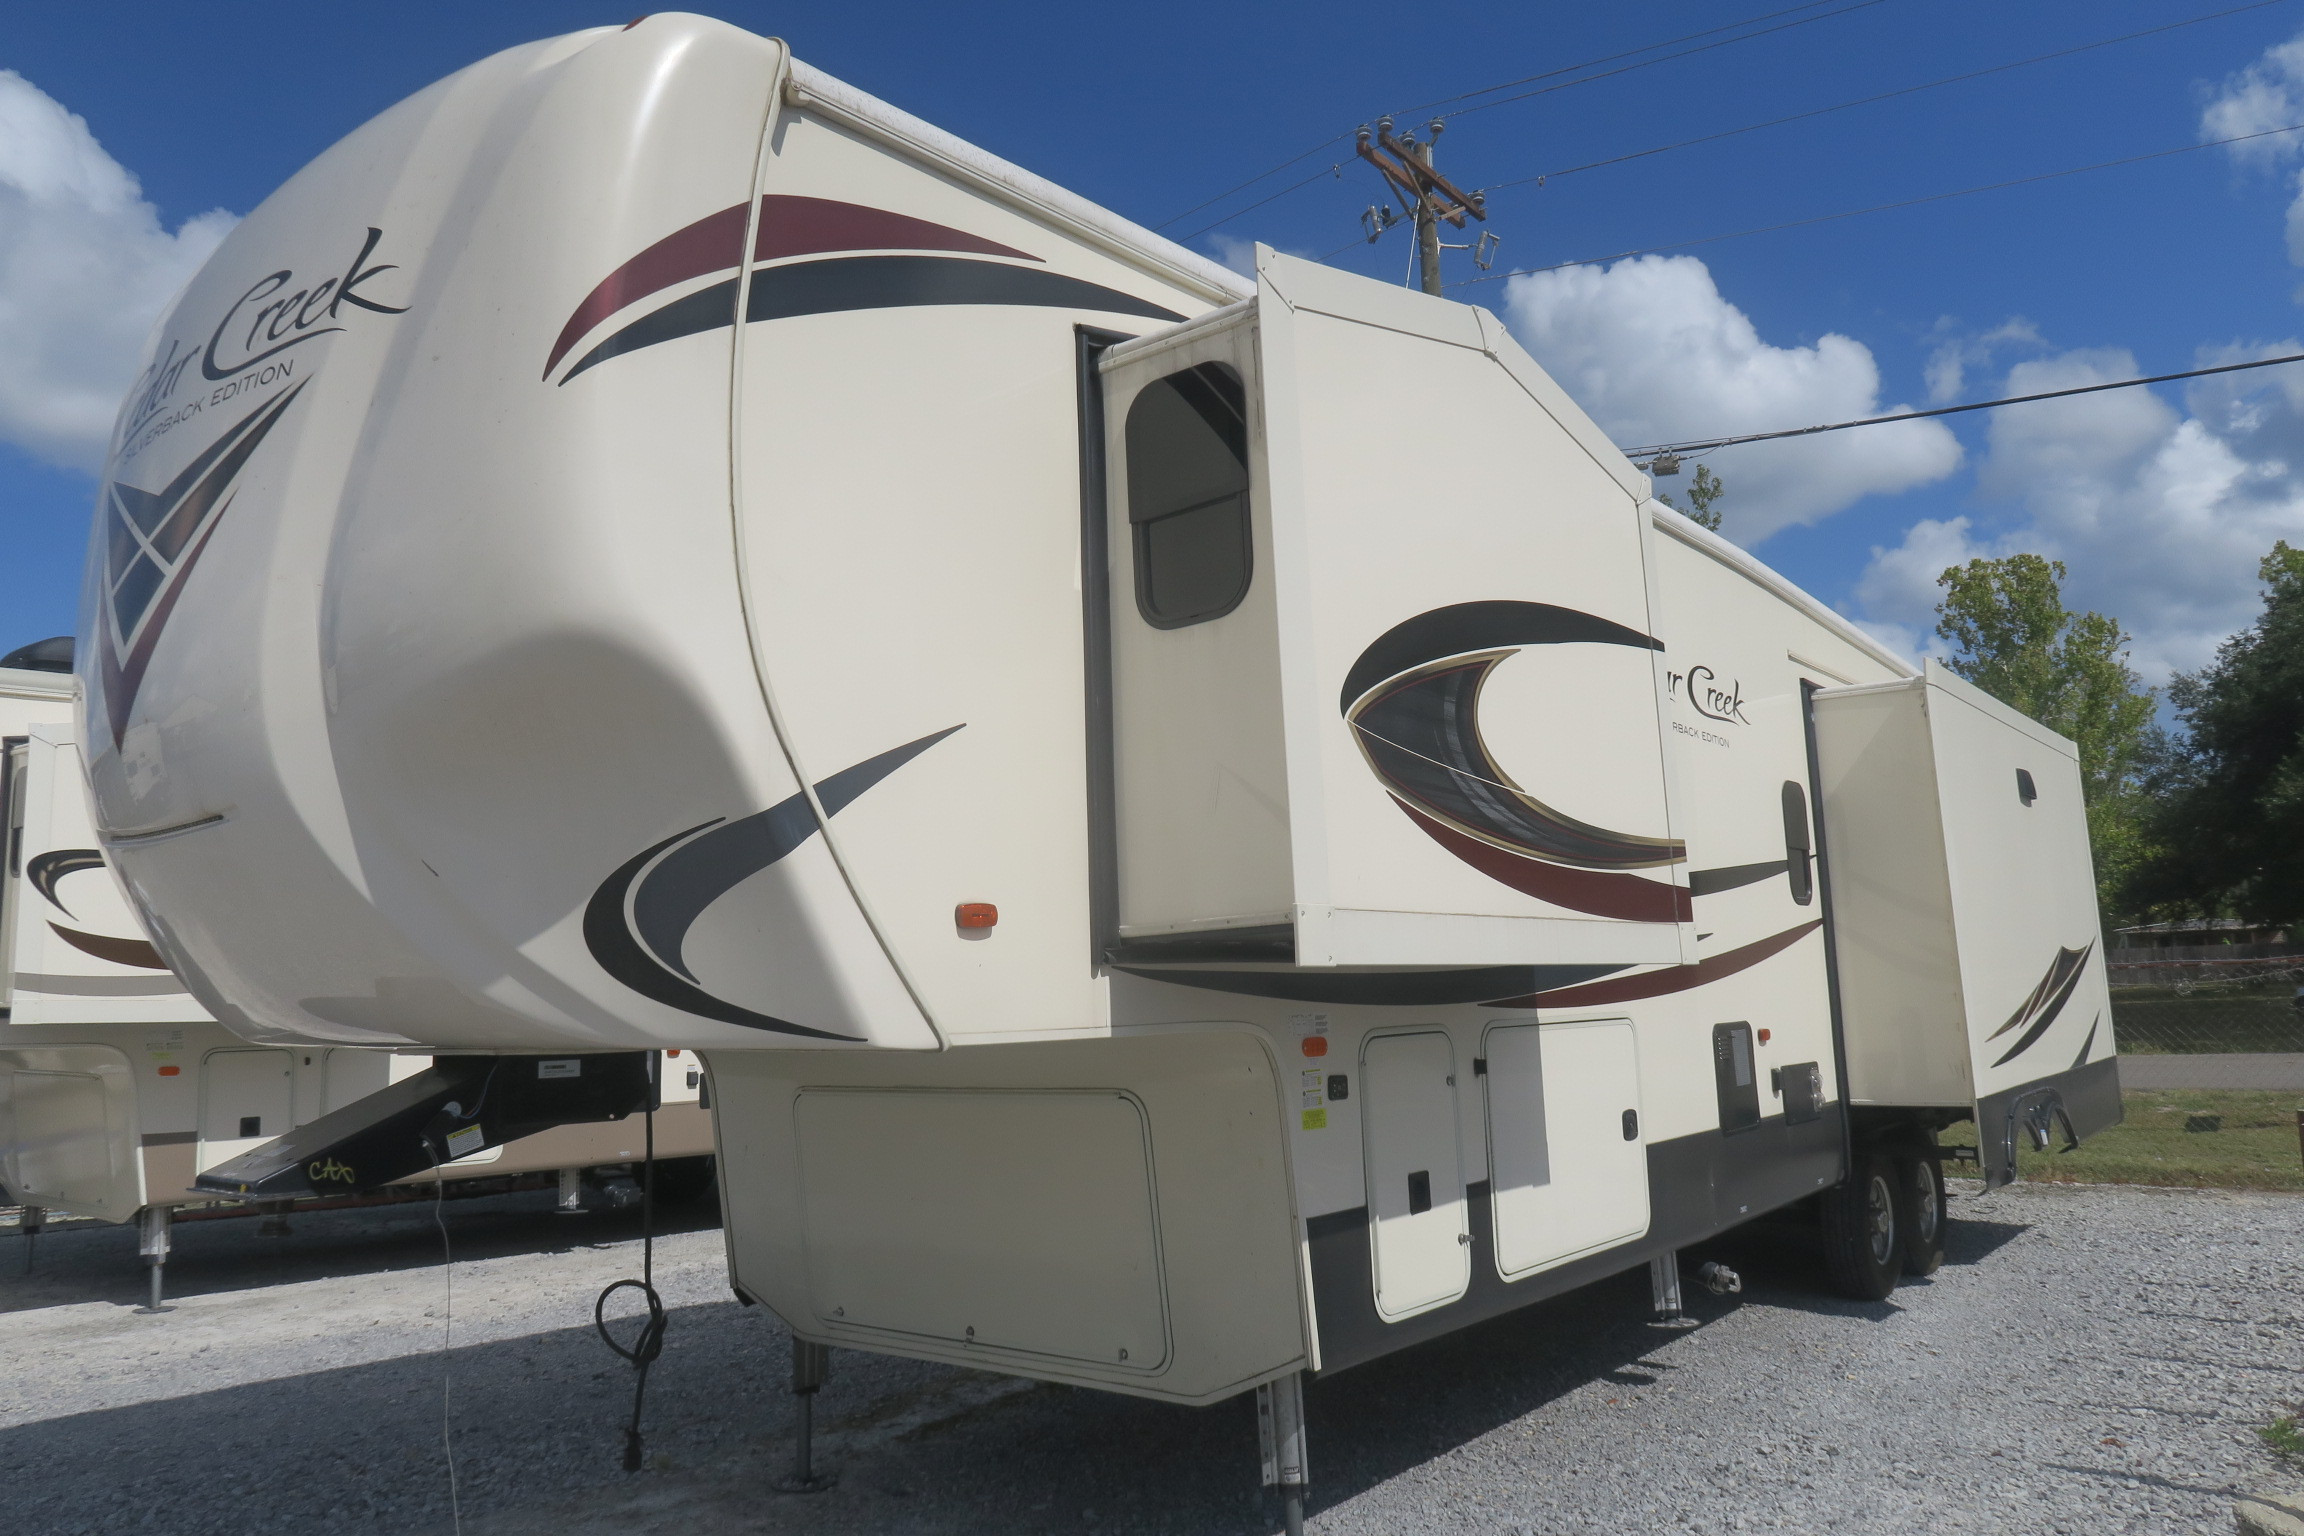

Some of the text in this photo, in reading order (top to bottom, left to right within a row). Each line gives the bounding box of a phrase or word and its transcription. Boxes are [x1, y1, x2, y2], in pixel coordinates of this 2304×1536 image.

[202, 226, 413, 381] Creek
[210, 359, 294, 407] EDITION
[1687, 665, 1751, 727] Creek
[1701, 731, 1730, 748] EDITION
